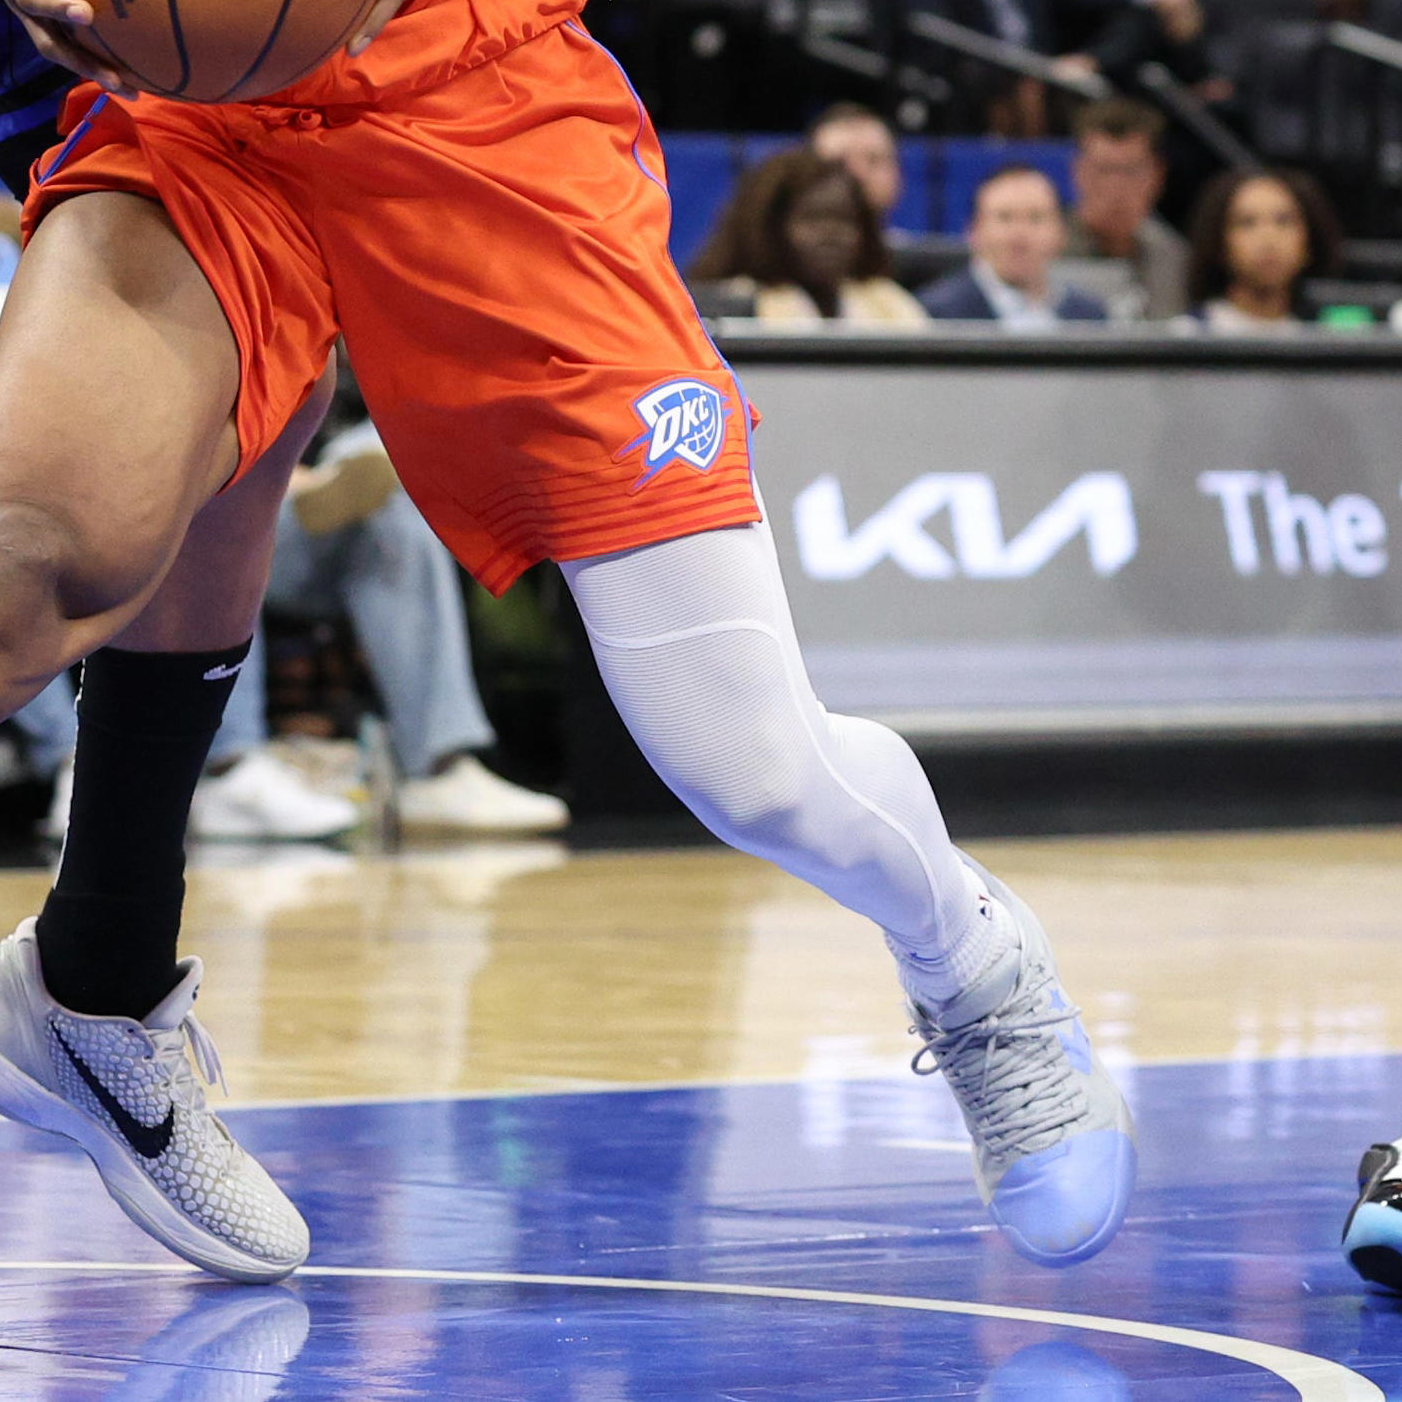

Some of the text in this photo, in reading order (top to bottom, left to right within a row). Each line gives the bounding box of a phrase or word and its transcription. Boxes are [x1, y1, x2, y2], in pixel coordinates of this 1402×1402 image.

[648, 394, 710, 462] OKC
[793, 471, 1139, 581] KIA
[1198, 467, 1389, 577] The
